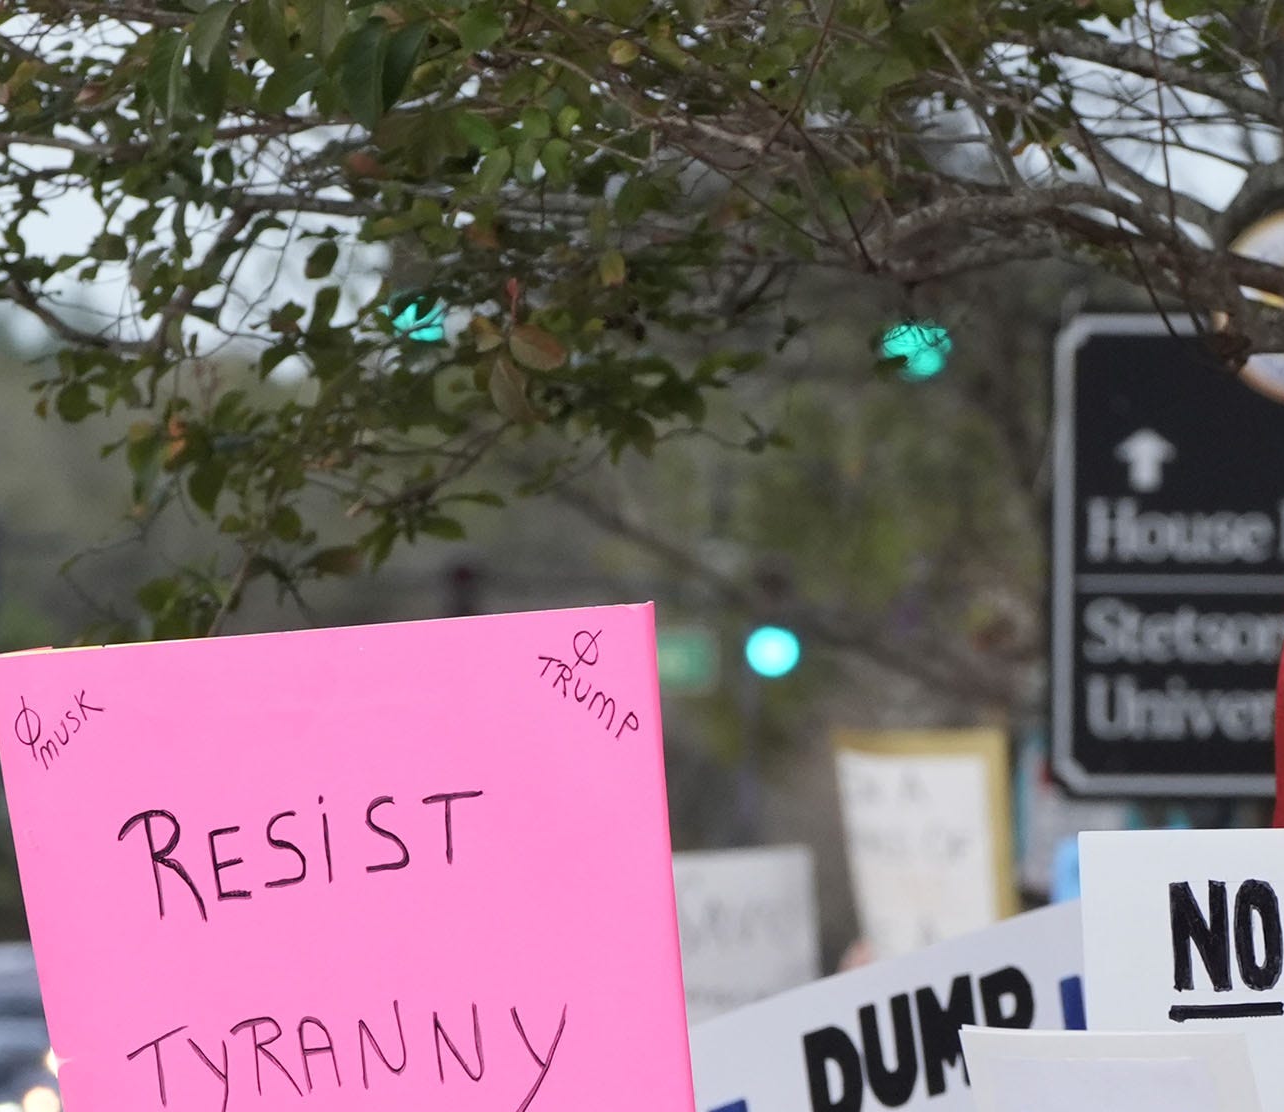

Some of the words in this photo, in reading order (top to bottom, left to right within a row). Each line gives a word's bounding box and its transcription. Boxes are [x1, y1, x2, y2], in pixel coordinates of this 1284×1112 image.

[1084, 496, 1273, 563] House
[538, 654, 639, 740] TRUMP
[1168, 878, 1284, 994] NO
